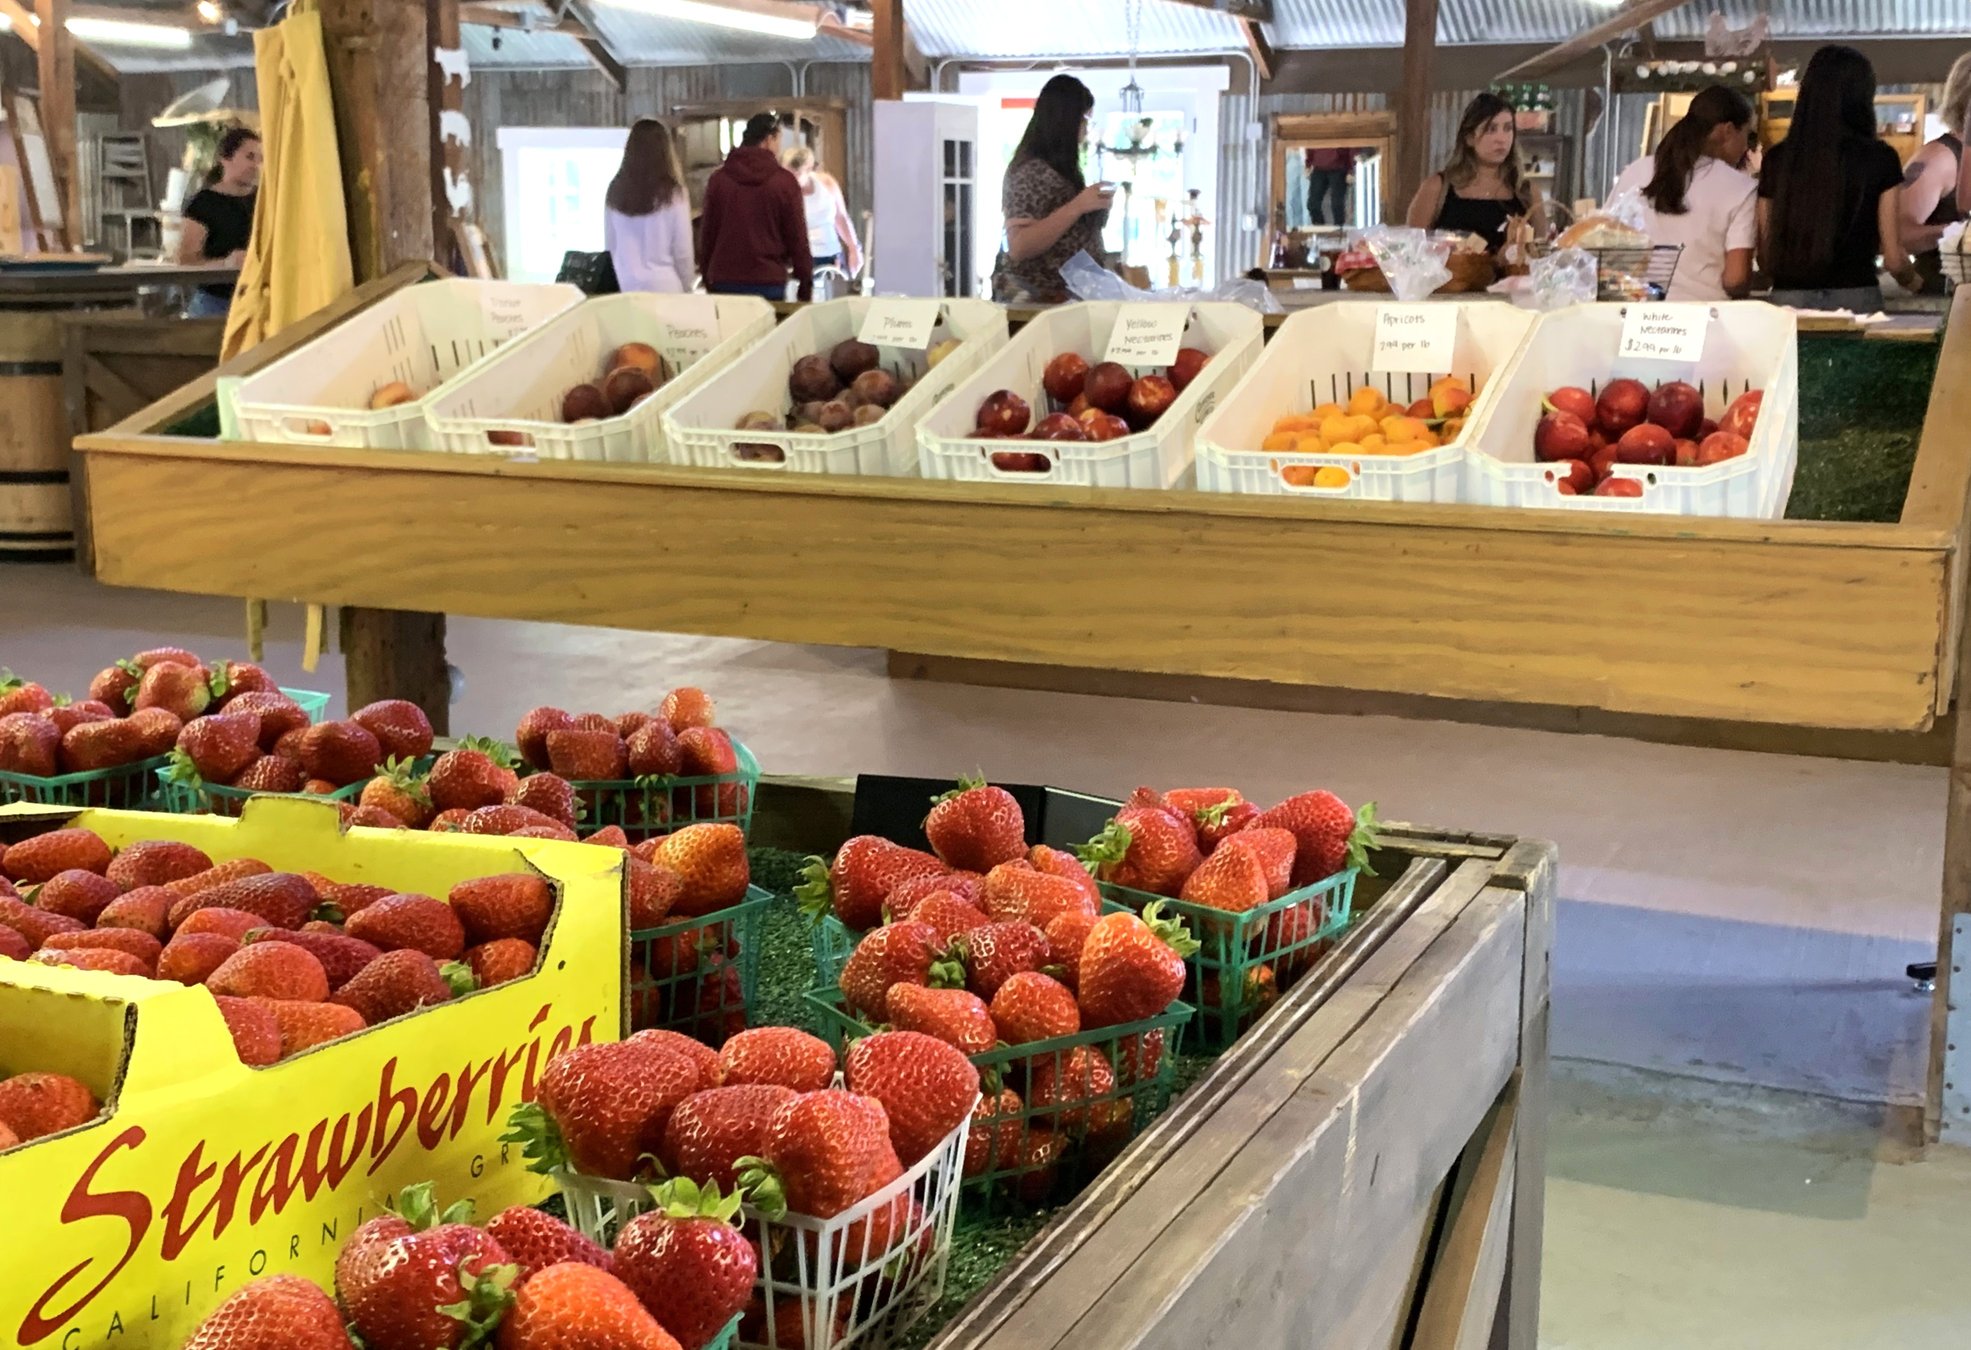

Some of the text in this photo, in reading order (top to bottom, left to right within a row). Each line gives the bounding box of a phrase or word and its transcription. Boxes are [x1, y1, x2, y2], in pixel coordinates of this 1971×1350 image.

[1383, 312, 1426, 327] Apricots
[1642, 312, 1673, 321] White
[1126, 319, 1158, 330] Yellow
[1640, 325, 1688, 336] Nectarines
[1124, 333, 1174, 344] Nectarines
[1401, 342, 1416, 352] per
[1420, 340, 1431, 349] lb
[1658, 346, 1670, 355] per
[61, 1193, 396, 1350] CALIFORNIA
